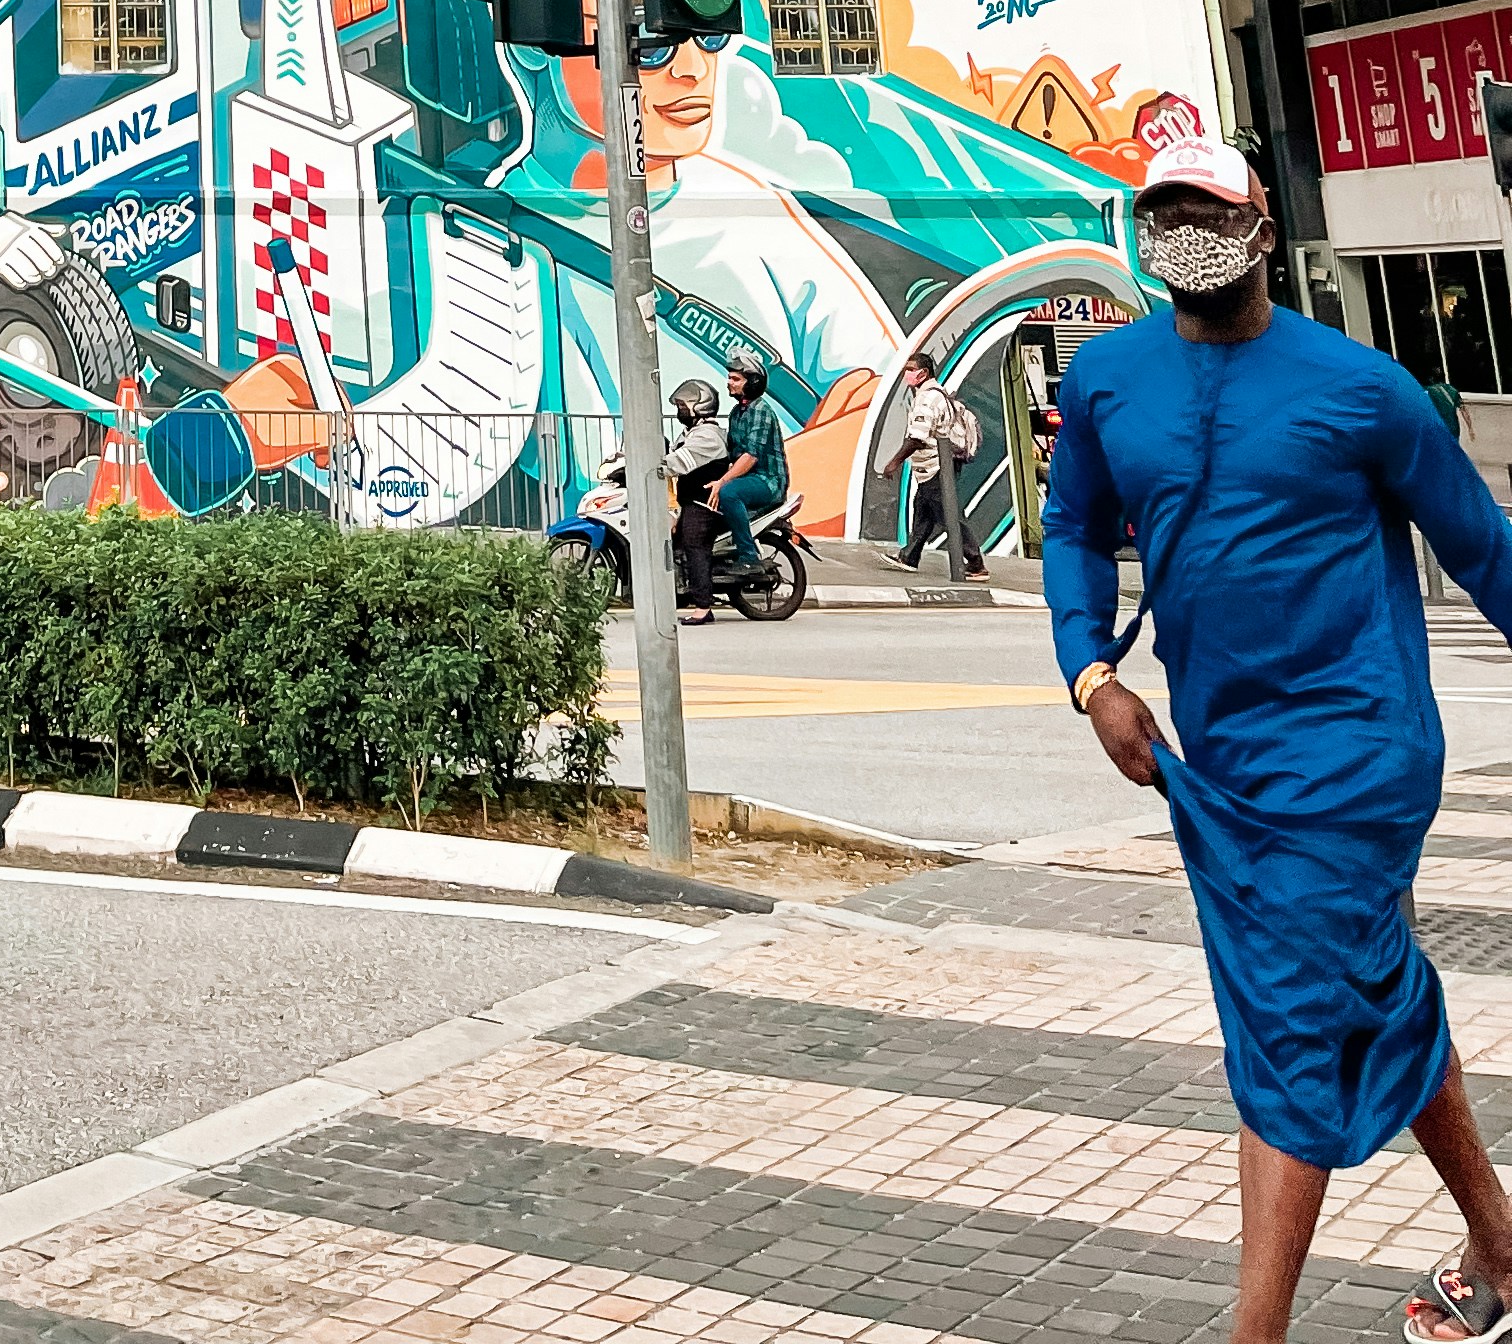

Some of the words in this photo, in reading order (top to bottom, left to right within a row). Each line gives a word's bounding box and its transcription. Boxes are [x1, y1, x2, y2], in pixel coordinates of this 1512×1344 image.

[1328, 75, 1353, 152] 1
[1419, 57, 1446, 141] 5
[28, 104, 162, 196] ALLIANZ
[70, 198, 139, 250] ROAD
[91, 196, 196, 273] RANGERS
[1056, 297, 1090, 321] 24
[368, 480, 429, 498] APPROVED
